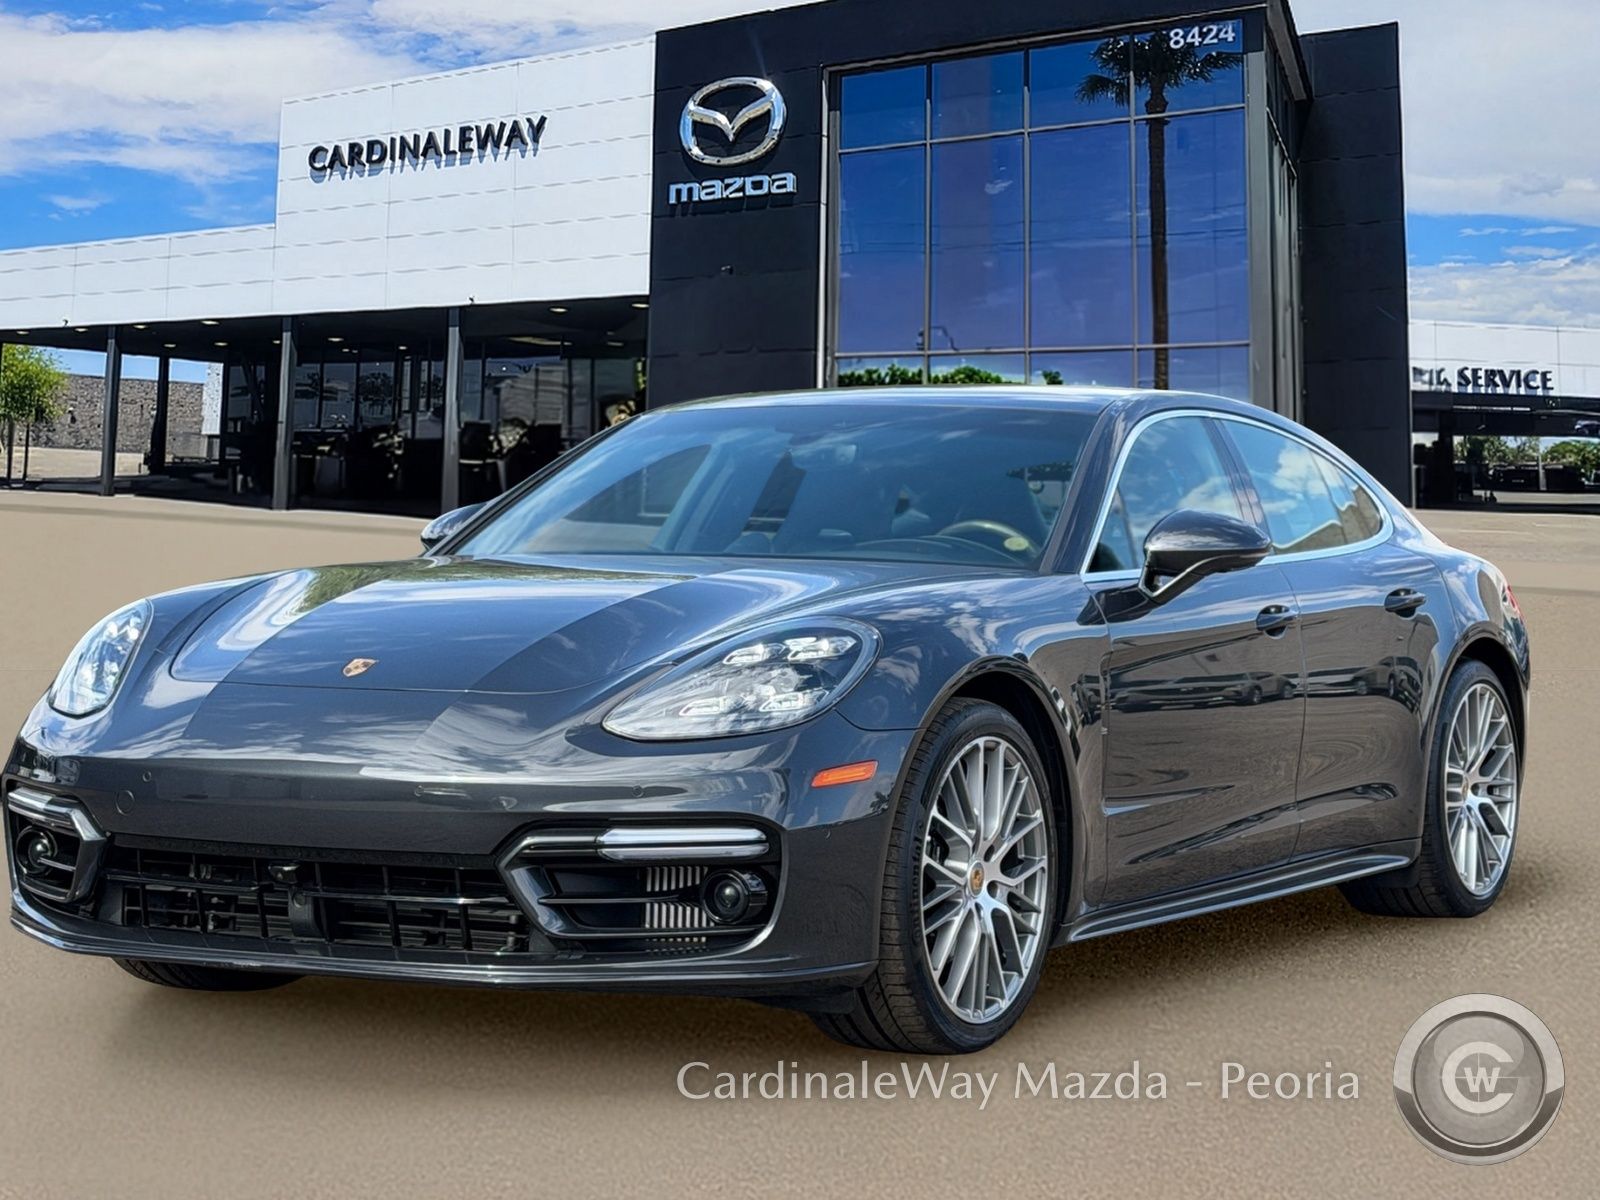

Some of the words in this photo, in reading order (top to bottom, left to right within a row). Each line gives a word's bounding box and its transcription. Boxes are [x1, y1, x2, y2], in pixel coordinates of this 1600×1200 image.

[1169, 23, 1236, 49] 8424
[308, 115, 548, 172] CARDINALEWAY
[1457, 366, 1554, 391] SERVICE
